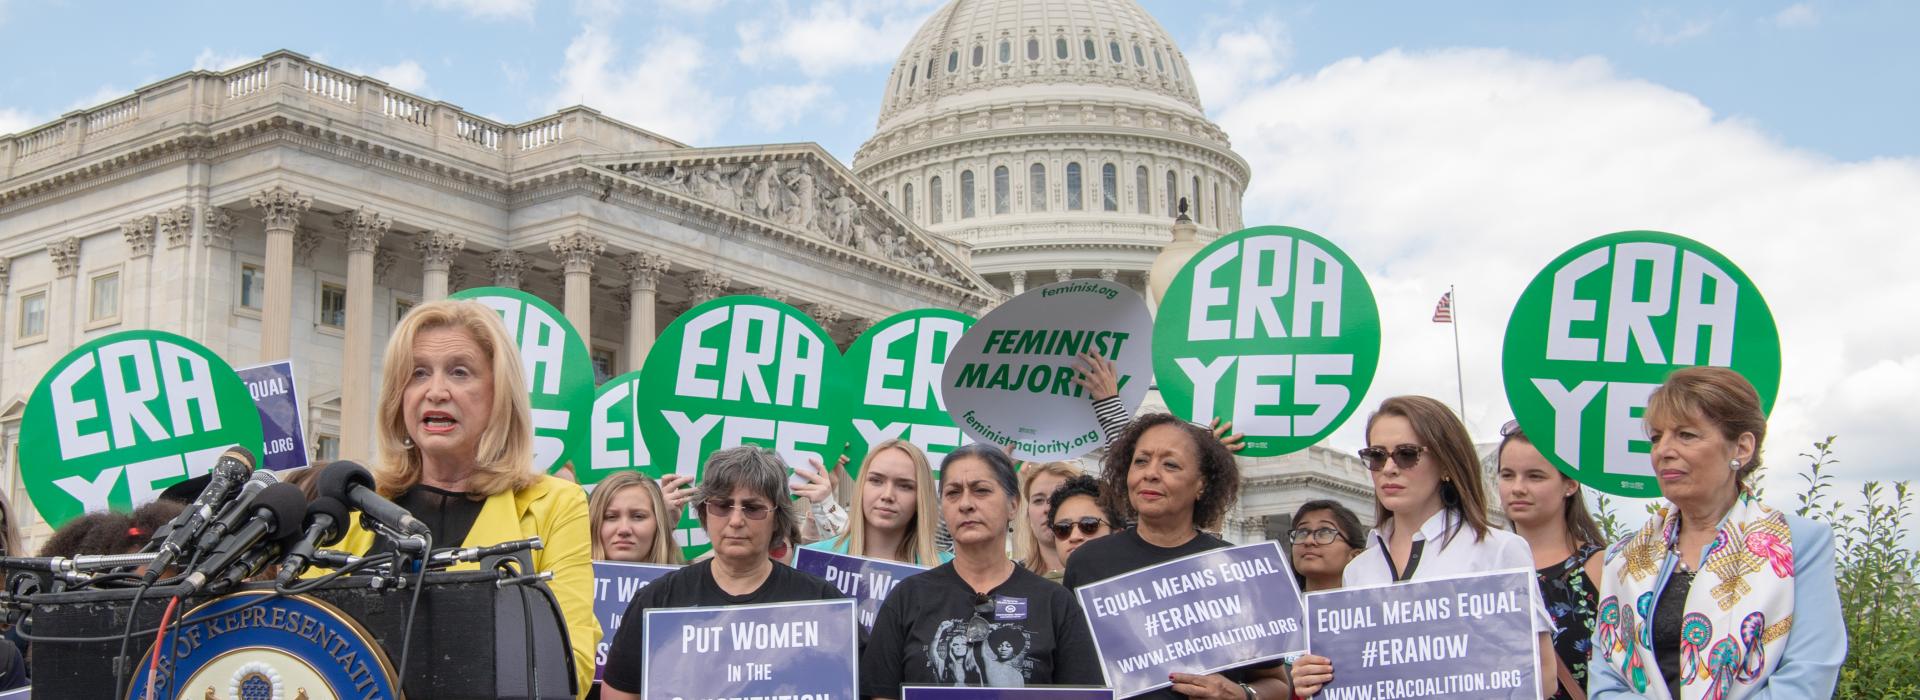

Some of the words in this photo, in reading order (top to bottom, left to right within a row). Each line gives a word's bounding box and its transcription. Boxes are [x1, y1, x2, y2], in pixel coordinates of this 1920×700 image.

[1042, 282, 1119, 300] feminist.org
[1188, 235, 1343, 341] ERA
[1546, 241, 1739, 367] ERA
[675, 304, 825, 410] ERA
[864, 317, 964, 412] ER
[982, 329, 1130, 361] FEMINIST
[50, 339, 222, 461] ERA
[243, 377, 288, 402] QUAL
[954, 362, 1131, 400] MAJORI
[1174, 354, 1354, 437] YES
[963, 410, 1100, 456] feministmajority.org
[1530, 378, 1664, 477] YE
[826, 565, 862, 597] PUT
[1093, 587, 1151, 617] EQUAL
[1152, 568, 1217, 600] MEANS
[1219, 557, 1279, 583] EQUAL
[1318, 606, 1377, 634] EQUAL
[1382, 597, 1451, 626] MEANS
[1458, 590, 1522, 620] EQUAL
[176, 625, 201, 660] OF
[682, 625, 723, 654] PUT
[731, 621, 819, 651] WOMEN
[728, 664, 741, 682] IN
[746, 663, 772, 681] THE
